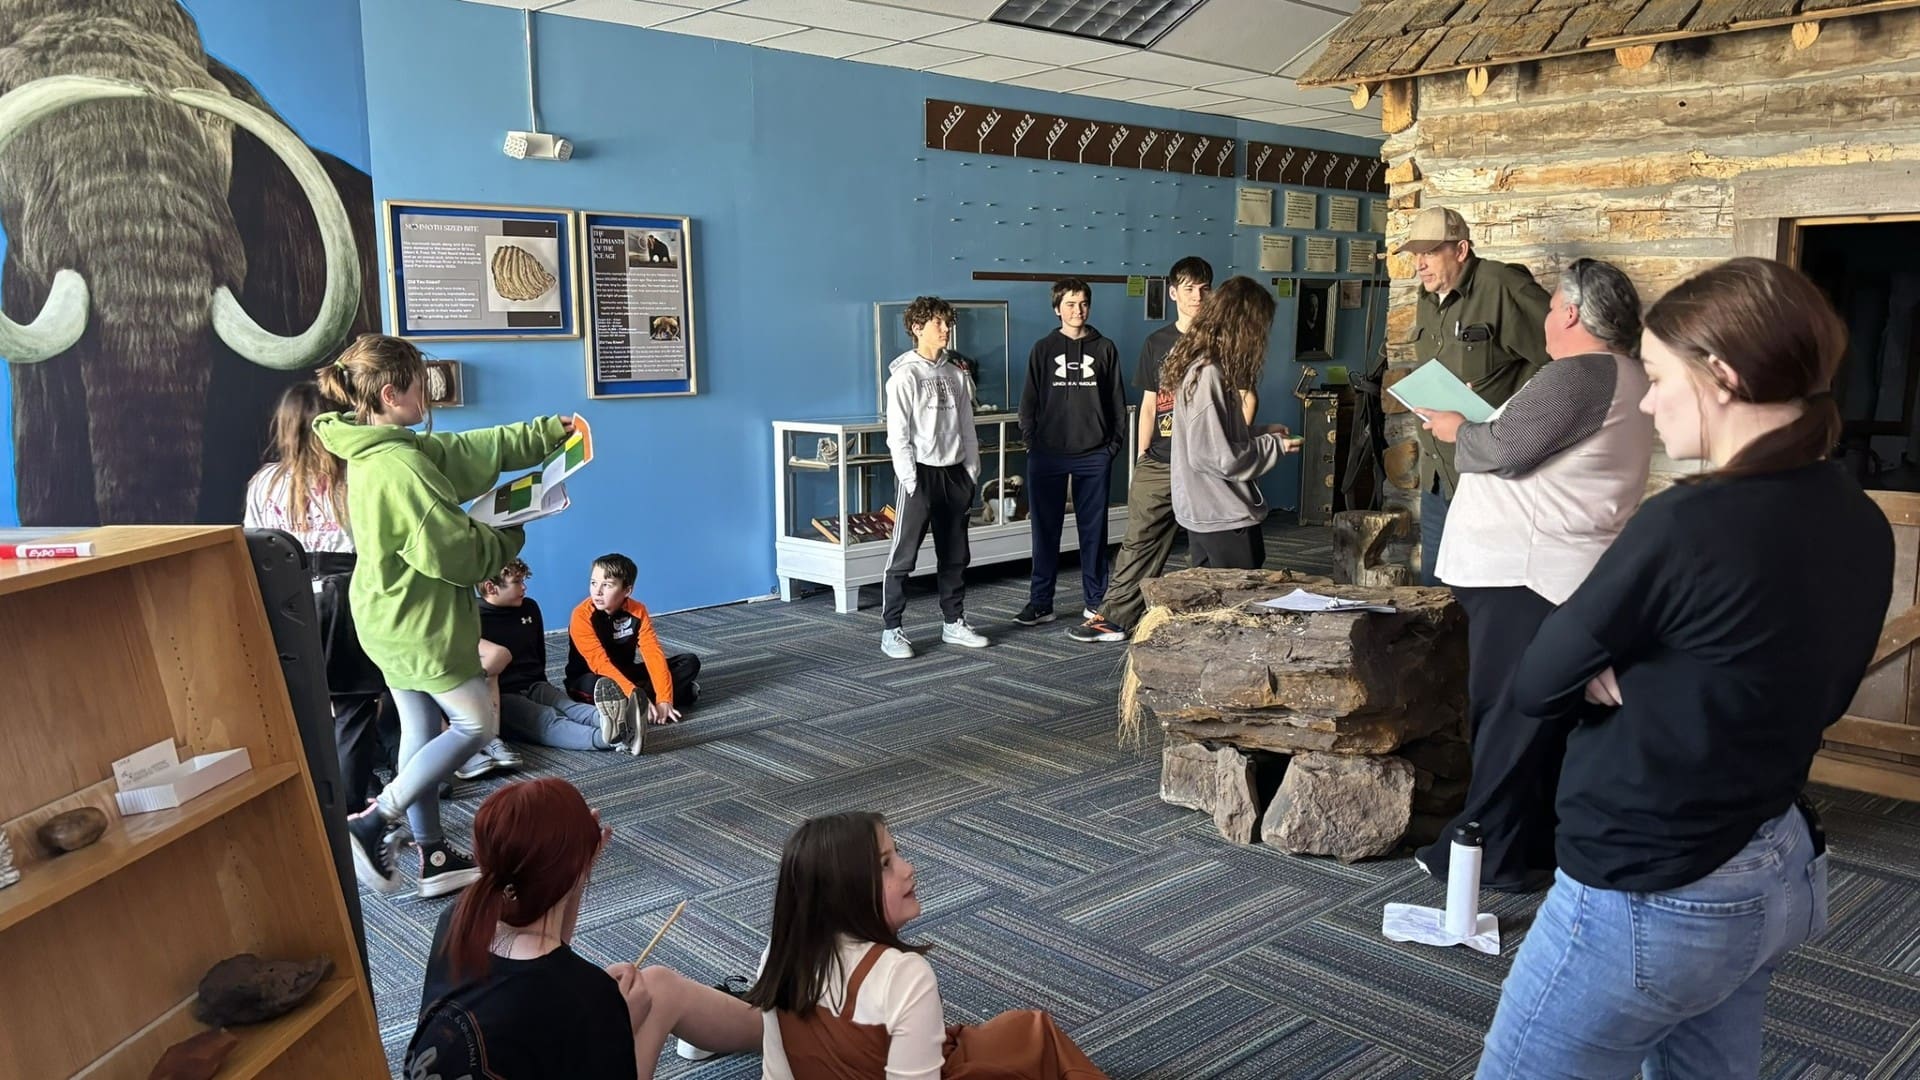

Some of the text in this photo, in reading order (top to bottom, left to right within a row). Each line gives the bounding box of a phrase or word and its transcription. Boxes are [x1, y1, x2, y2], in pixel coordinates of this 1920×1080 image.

[940, 105, 962, 133] 1850
[977, 108, 1000, 138] 1851
[1012, 114, 1033, 141] 1852
[1046, 118, 1065, 145] 1853
[1077, 122, 1096, 148] 1854
[1108, 125, 1127, 152] 1855
[1138, 130, 1155, 155] 1856
[1165, 133, 1181, 158] 1857
[1191, 136, 1207, 161] 1858
[1217, 139, 1232, 163] 1859
[1255, 145, 1269, 168] 1860
[1278, 147, 1293, 169] 1861
[1301, 151, 1315, 173] 1862
[1323, 154, 1338, 176] 1863
[1345, 157, 1358, 178] 1864
[28, 549, 55, 558] EXPO
